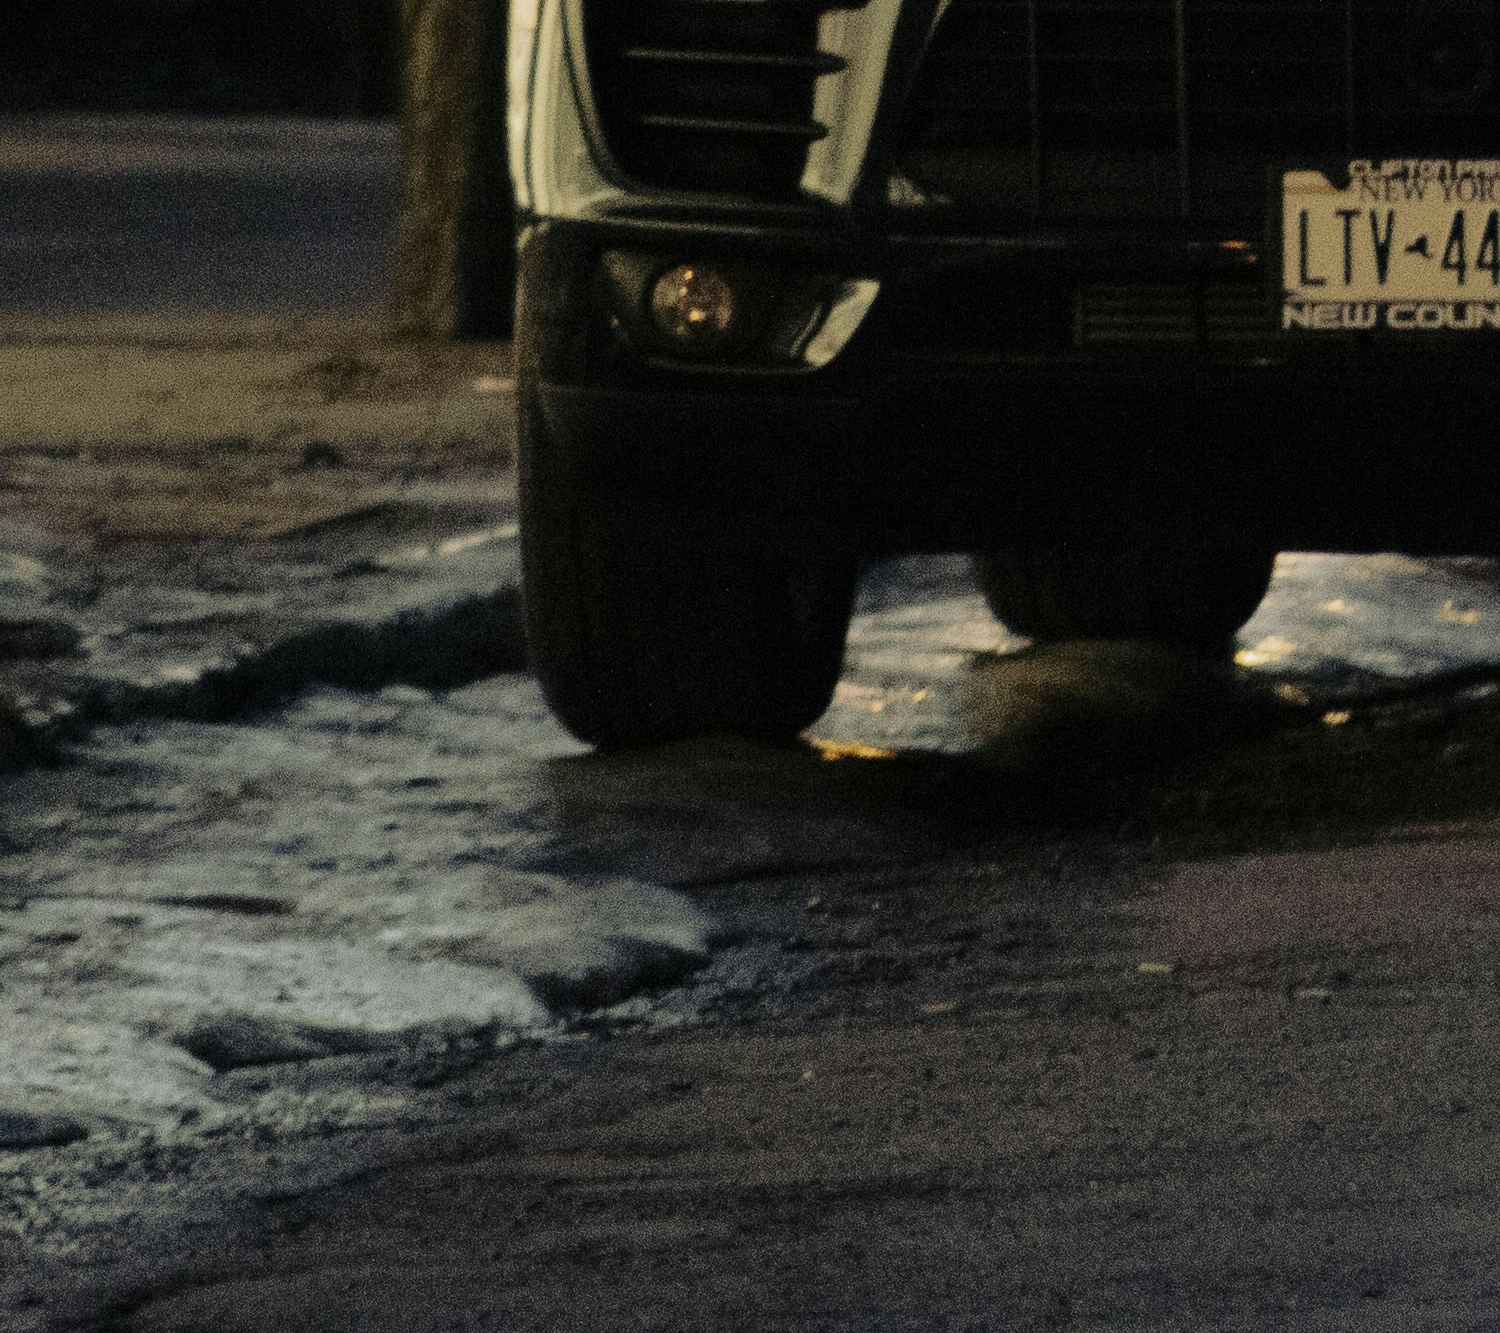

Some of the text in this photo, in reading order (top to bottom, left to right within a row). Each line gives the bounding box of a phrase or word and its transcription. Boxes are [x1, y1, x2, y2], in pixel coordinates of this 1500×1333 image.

[1359, 177, 1426, 202] NEW
[1299, 208, 1396, 286] LTV
[1281, 302, 1377, 330] NEW
